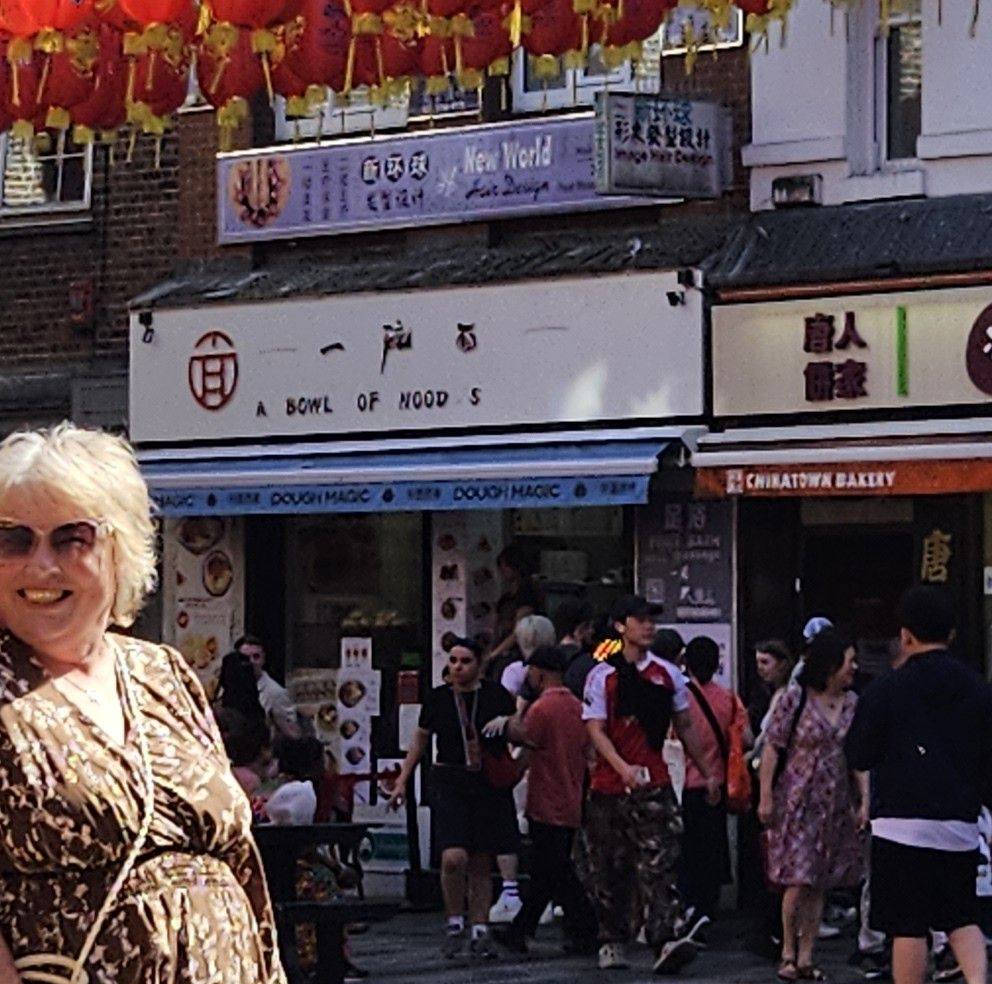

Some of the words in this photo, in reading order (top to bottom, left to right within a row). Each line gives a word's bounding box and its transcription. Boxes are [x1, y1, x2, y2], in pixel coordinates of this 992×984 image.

[464, 145, 499, 174] New
[502, 133, 553, 170] World
[256, 401, 268, 418] A
[286, 395, 334, 416] BOWL
[357, 391, 382, 413] OF
[746, 472, 833, 490] CHINATOWN
[835, 471, 897, 489] BAKERY
[271, 490, 323, 507] DOUGH
[325, 488, 371, 504] MAGIC
[453, 484, 508, 502] DOUGH
[512, 482, 561, 500] MAGIC
